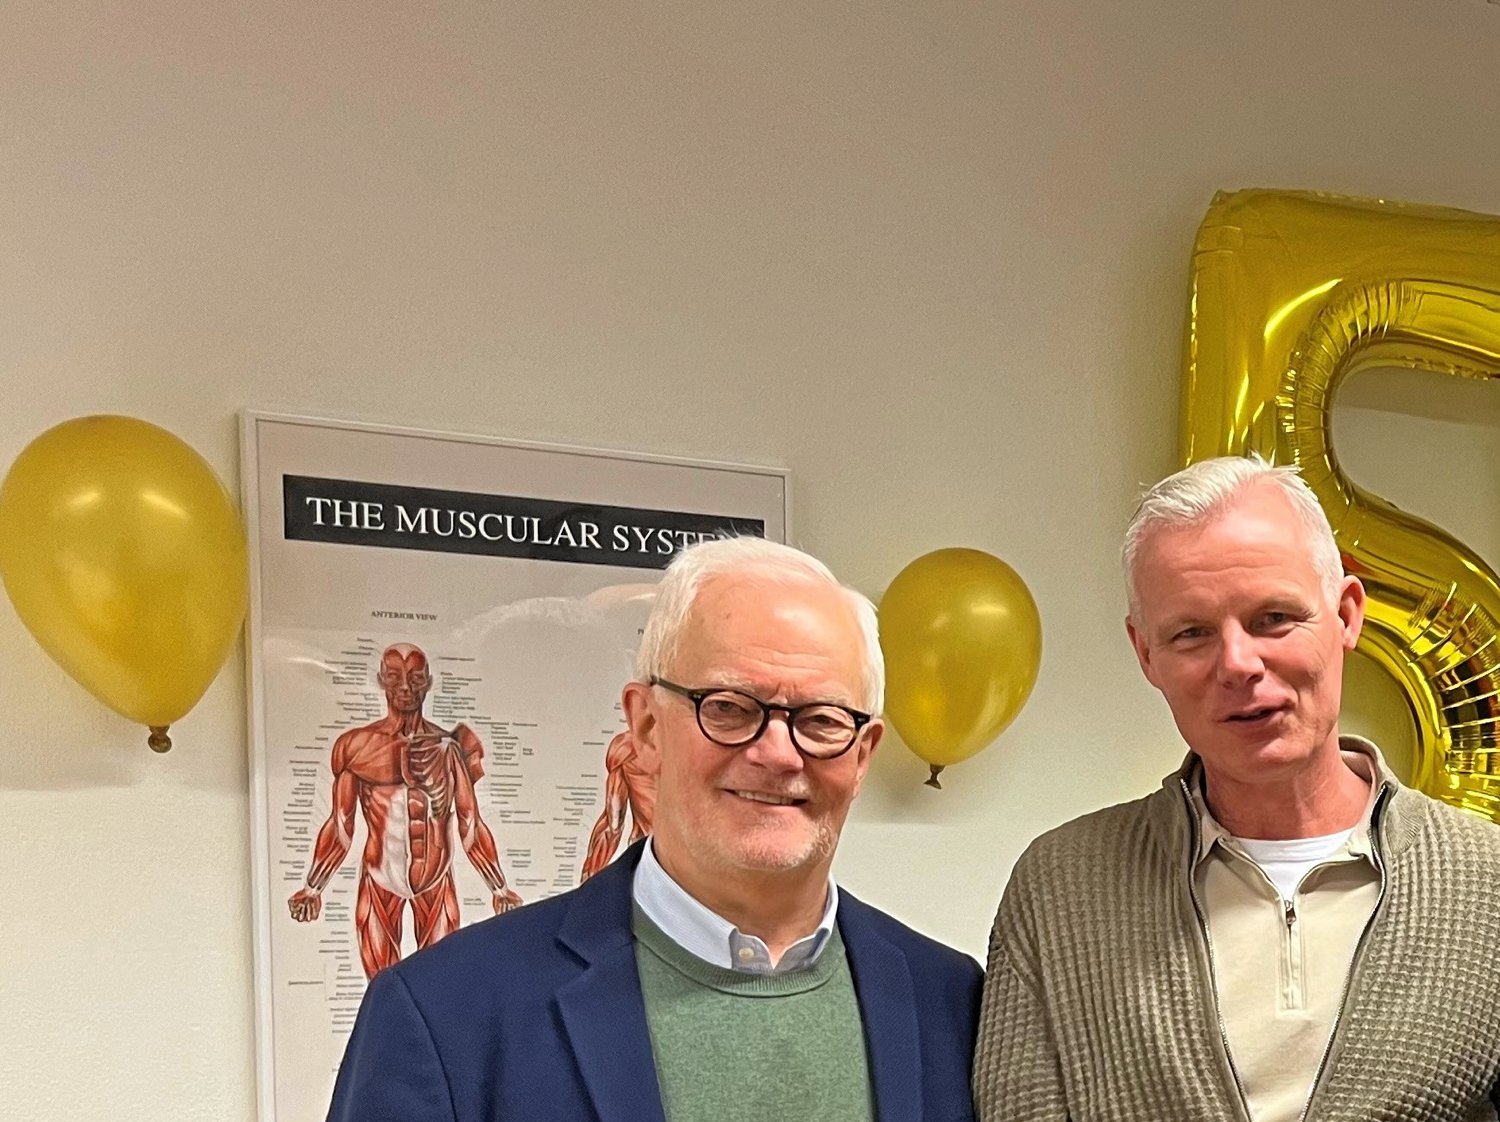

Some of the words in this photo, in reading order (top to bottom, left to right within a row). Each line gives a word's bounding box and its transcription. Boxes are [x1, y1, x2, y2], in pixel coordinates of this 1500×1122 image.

[306, 497, 385, 530] THE
[395, 504, 603, 550] MUSCULAR
[612, 524, 719, 555] SYST
[370, 611, 415, 620] ANTERIOR
[416, 613, 438, 621] VIEW
